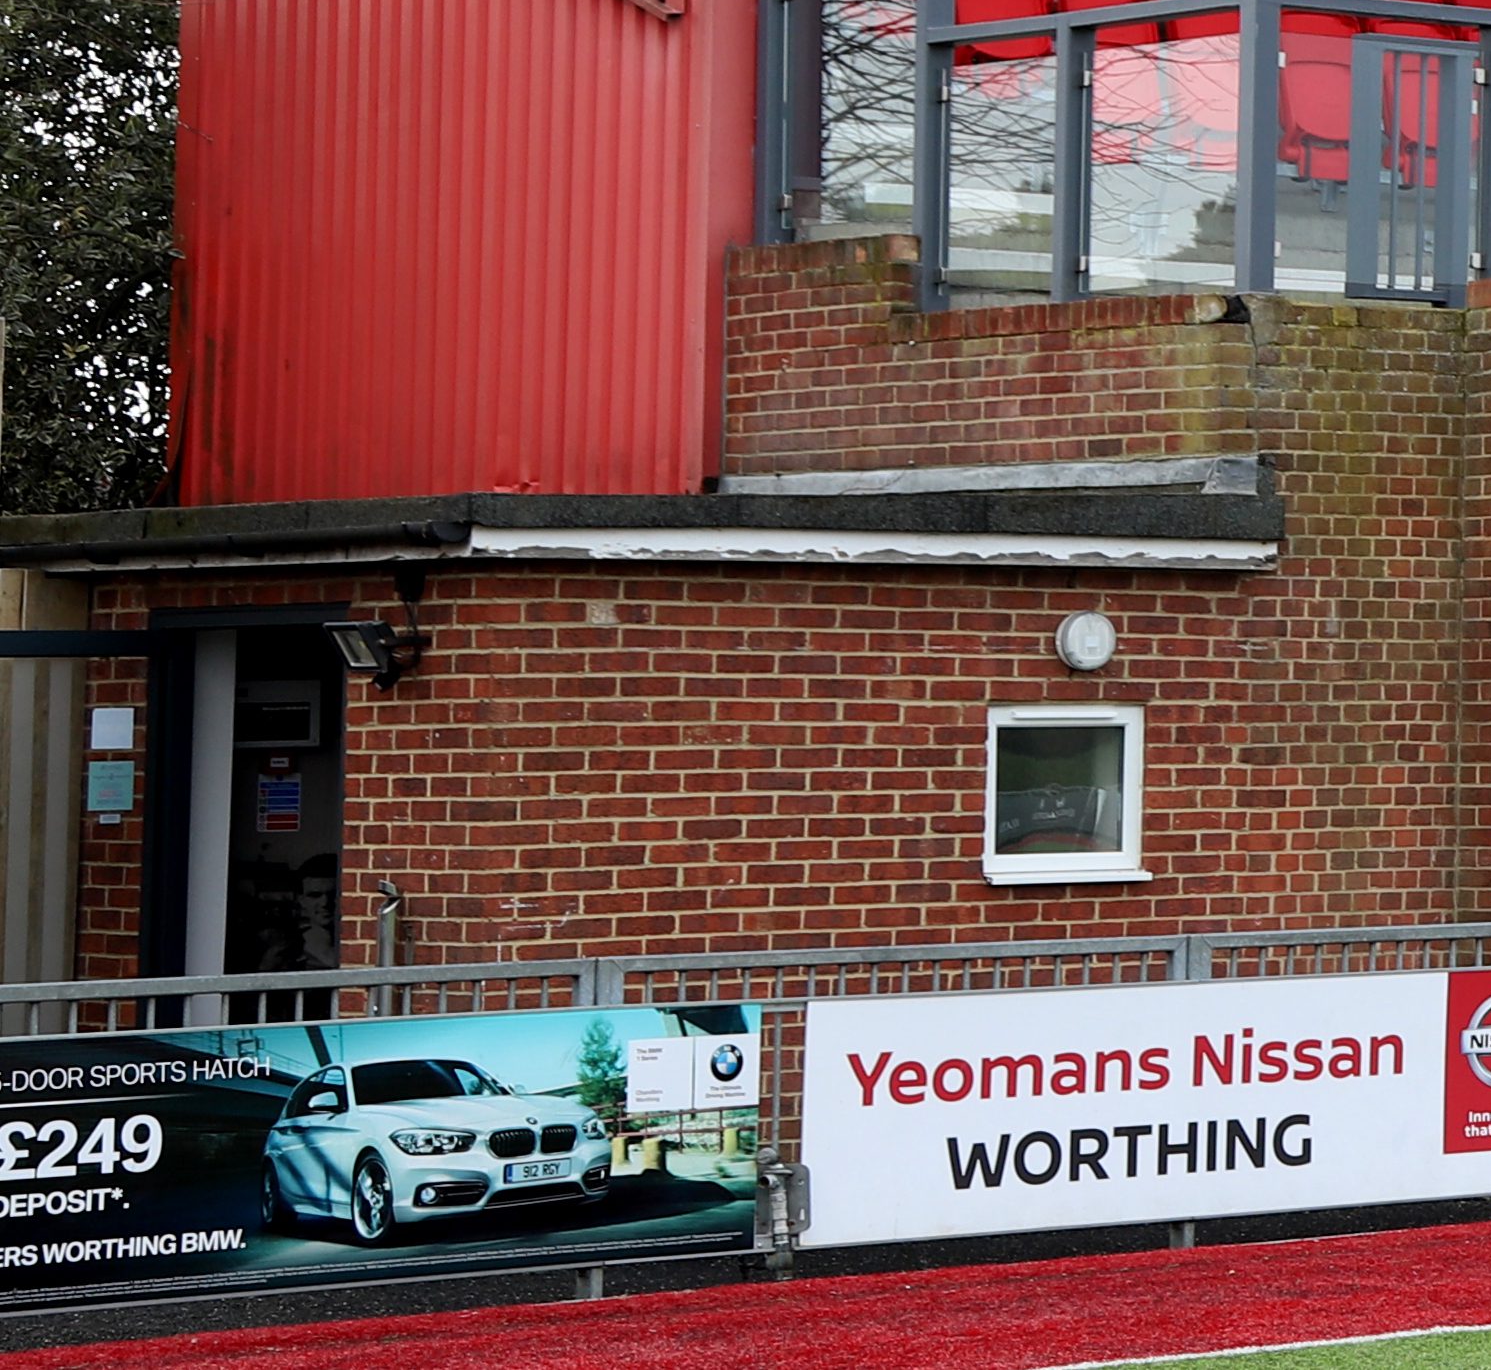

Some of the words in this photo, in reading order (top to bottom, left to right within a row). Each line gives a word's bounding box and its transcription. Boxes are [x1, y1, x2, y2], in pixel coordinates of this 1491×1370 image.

[90, 1061, 187, 1088] SPORTS
[193, 1056, 271, 1080] HATCH
[847, 1045, 1171, 1108] Yeomans
[1192, 1028, 1405, 1089] Nissan
[0, 1114, 163, 1181] £249
[947, 1114, 1313, 1191] WORTHING
[43, 1234, 176, 1264] WORTHING
[181, 1229, 246, 1253] BMW.
